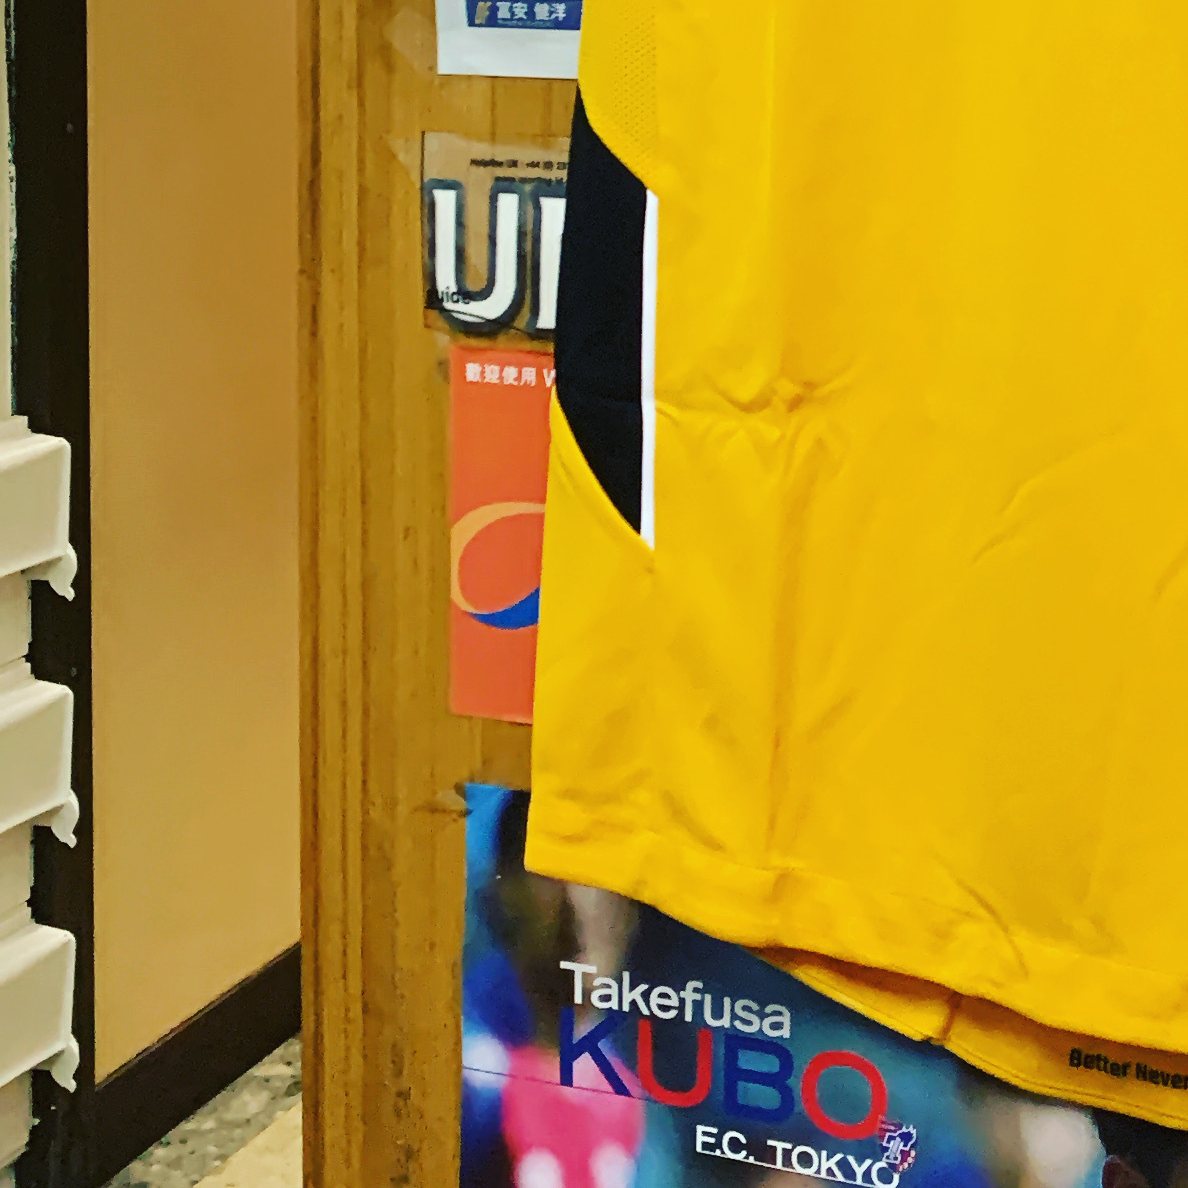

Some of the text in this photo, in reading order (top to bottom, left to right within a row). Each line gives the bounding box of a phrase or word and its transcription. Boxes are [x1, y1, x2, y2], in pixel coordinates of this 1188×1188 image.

[465, 363, 537, 387] 歡迎使用
[559, 960, 791, 1039] Takefusa
[559, 1007, 888, 1141] KUBO
[1069, 1047, 1131, 1078] Better
[696, 1125, 900, 1188] F.C. TOKYO
